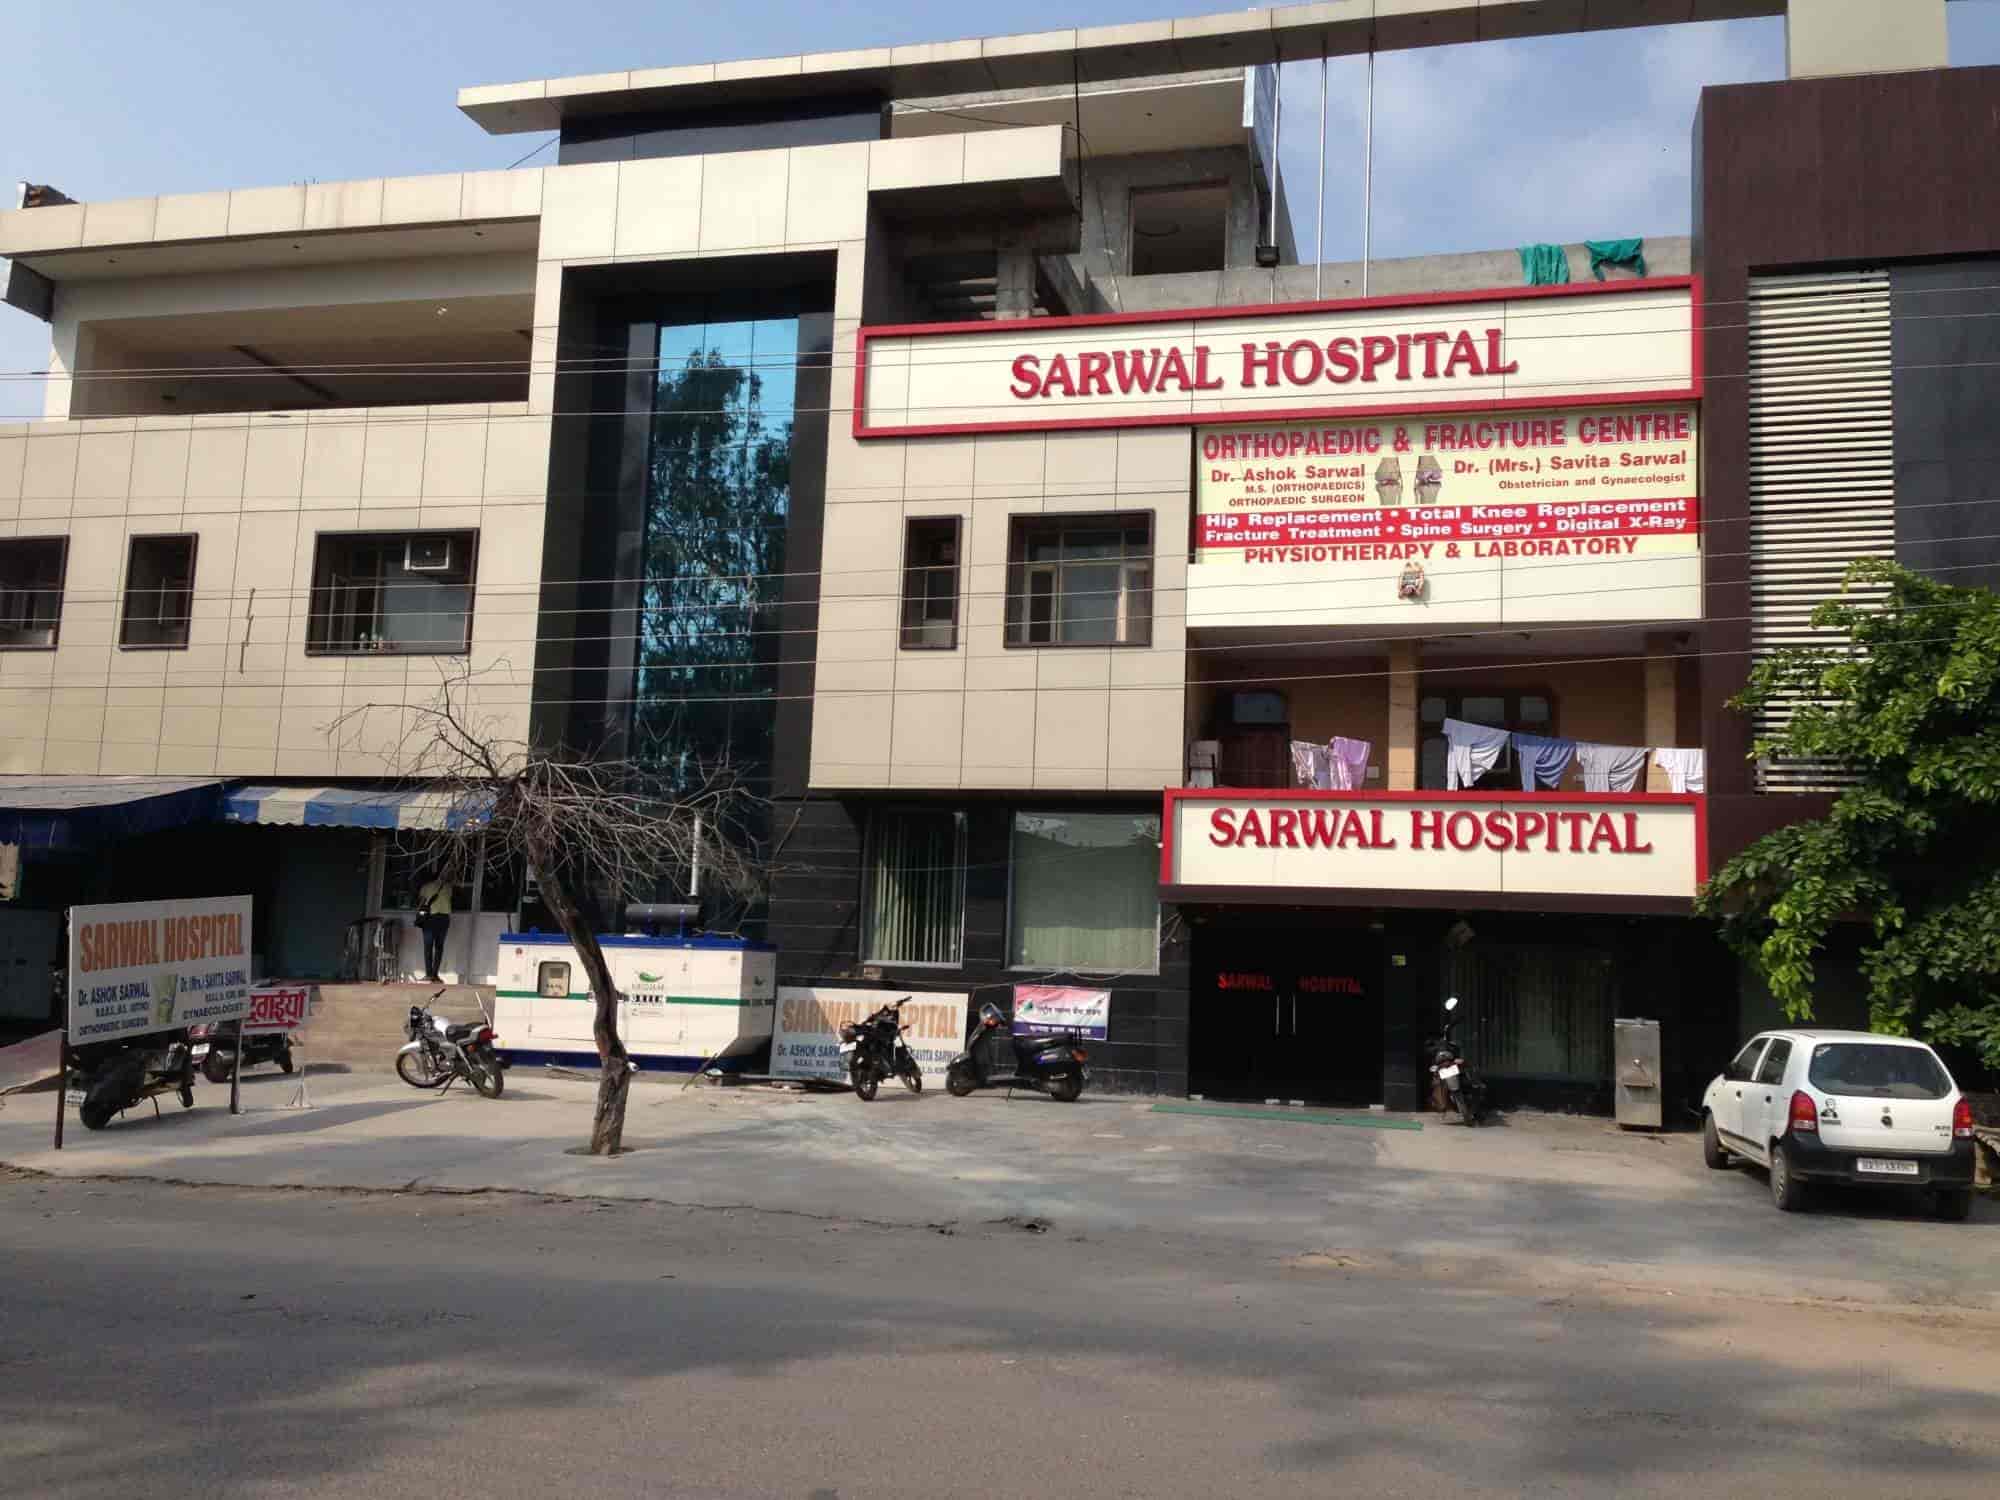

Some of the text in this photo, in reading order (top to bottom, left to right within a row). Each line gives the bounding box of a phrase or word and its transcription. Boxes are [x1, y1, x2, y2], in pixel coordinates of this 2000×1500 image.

[1010, 328, 1519, 399] SARWAL HOSPITAL
[1203, 412, 1690, 460] ORTHOPAEDIC & FRACTURE CENTRE
[1212, 464, 1365, 482] Dr. Ashok Sarwal
[1454, 450, 1686, 475] Dr. (Mrs.) Savita Sarwal
[1245, 481, 1365, 494] M.S. (ORTHOPAEDICS)
[1499, 473, 1686, 489] Obstetrician and Gynaecologist
[1206, 499, 1686, 529] Hip Replacement Total Knee Replacement
[1229, 494, 1365, 507] ORTHOPAEDIC SURGEON
[1206, 515, 1686, 542] Fracture Treatment Spine Surgery Digital X-Ray
[1244, 536, 1639, 564] PHYSIOTHERAPY & LABORATORY
[1210, 807, 1652, 854] SARWAL HOSPITAL
[80, 912, 244, 973] SARWAL HOSPITAL
